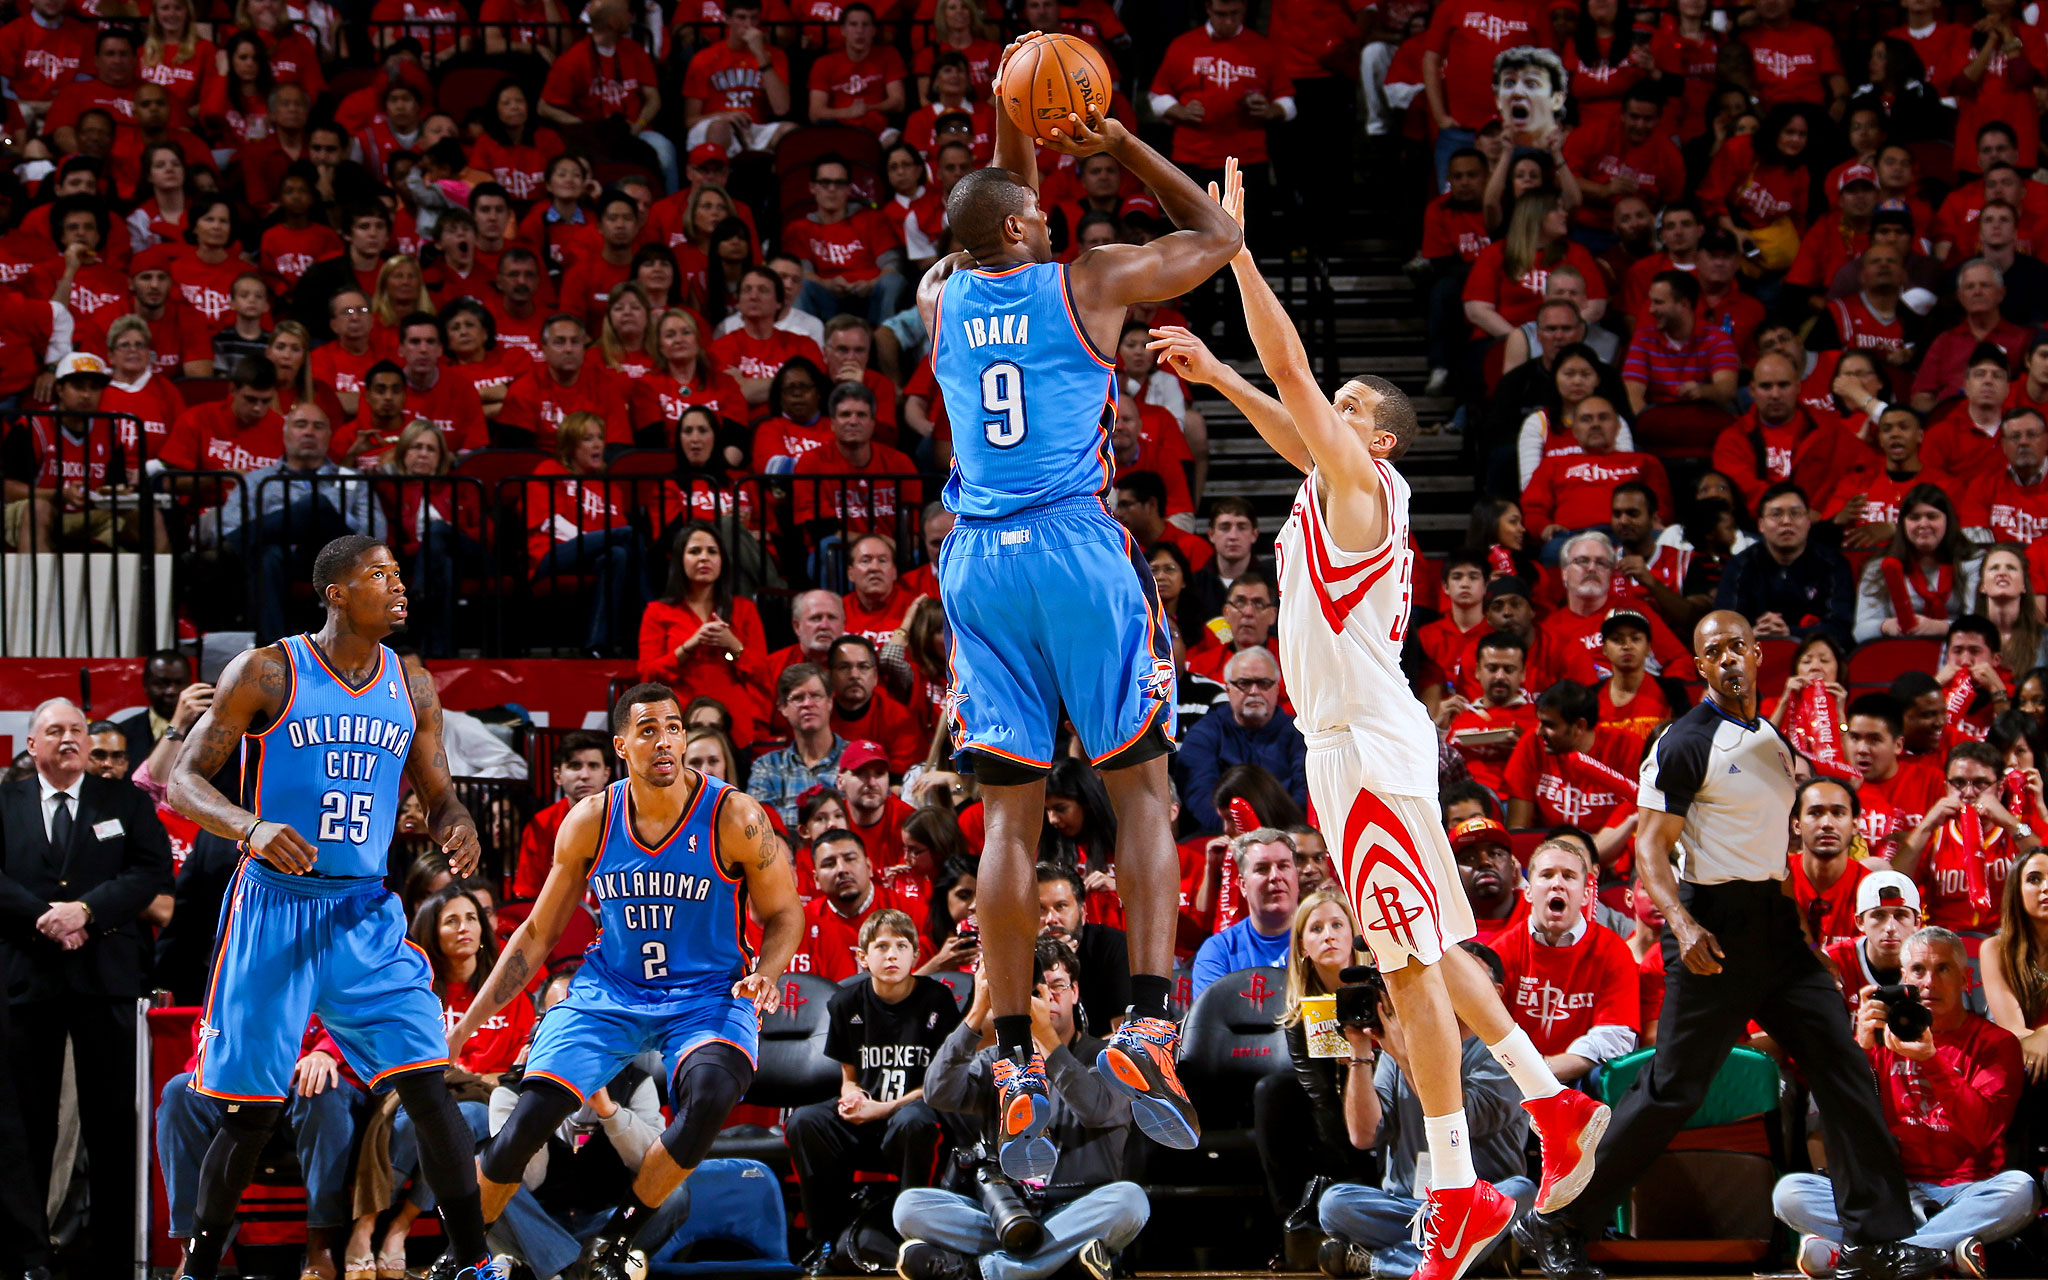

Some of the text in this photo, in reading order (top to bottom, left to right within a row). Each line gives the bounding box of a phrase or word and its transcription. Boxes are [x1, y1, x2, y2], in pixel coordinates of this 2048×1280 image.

[963, 314, 1029, 349] IBAKA
[982, 360, 1029, 450] 9
[1000, 529, 1031, 546] THUNDER
[287, 714, 410, 759] OKLAHOMA
[325, 750, 380, 783] CITY
[317, 789, 375, 846] 25
[593, 870, 712, 902] OKLAHOMA
[623, 902, 676, 932] CITY
[641, 939, 669, 981] 2
[861, 1045, 931, 1069] ROCKETS
[880, 1068, 907, 1103] 13
